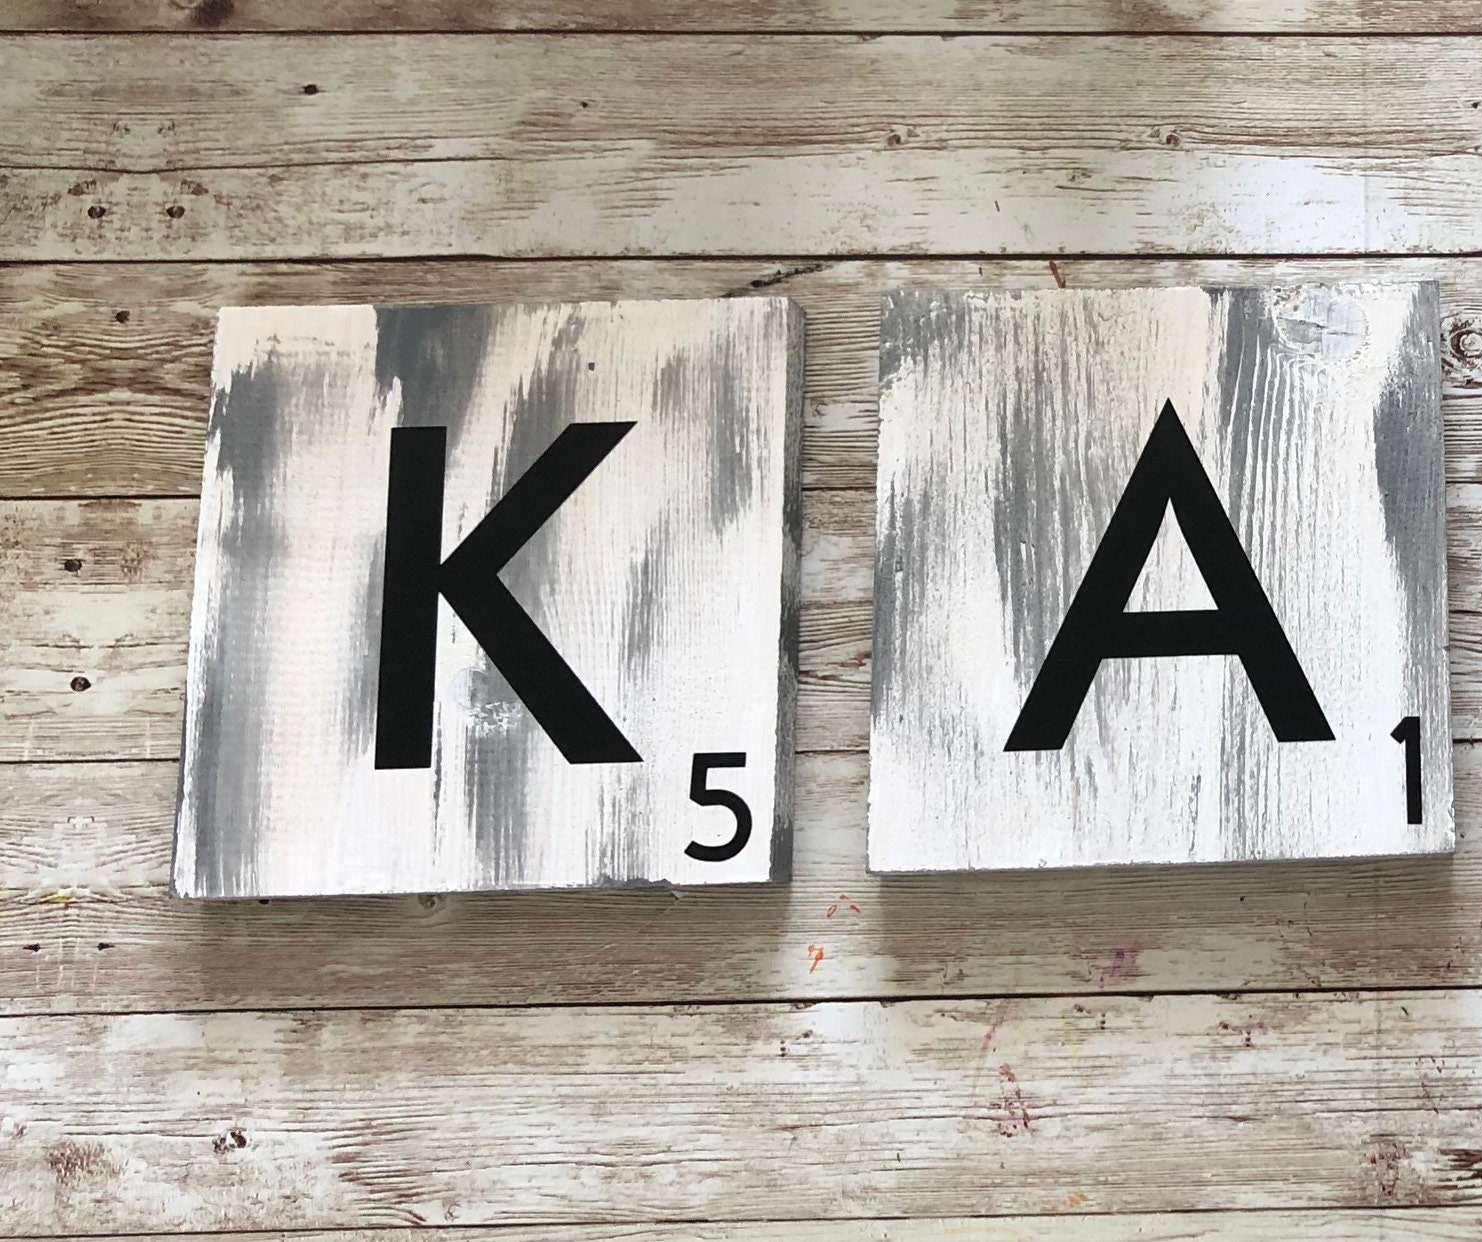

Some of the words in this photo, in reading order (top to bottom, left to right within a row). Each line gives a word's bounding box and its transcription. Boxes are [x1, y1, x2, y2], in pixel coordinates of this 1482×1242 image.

[374, 421, 644, 770] K
[1003, 397, 1336, 752] A
[684, 752, 752, 862] 5
[1390, 716, 1423, 825] 1
